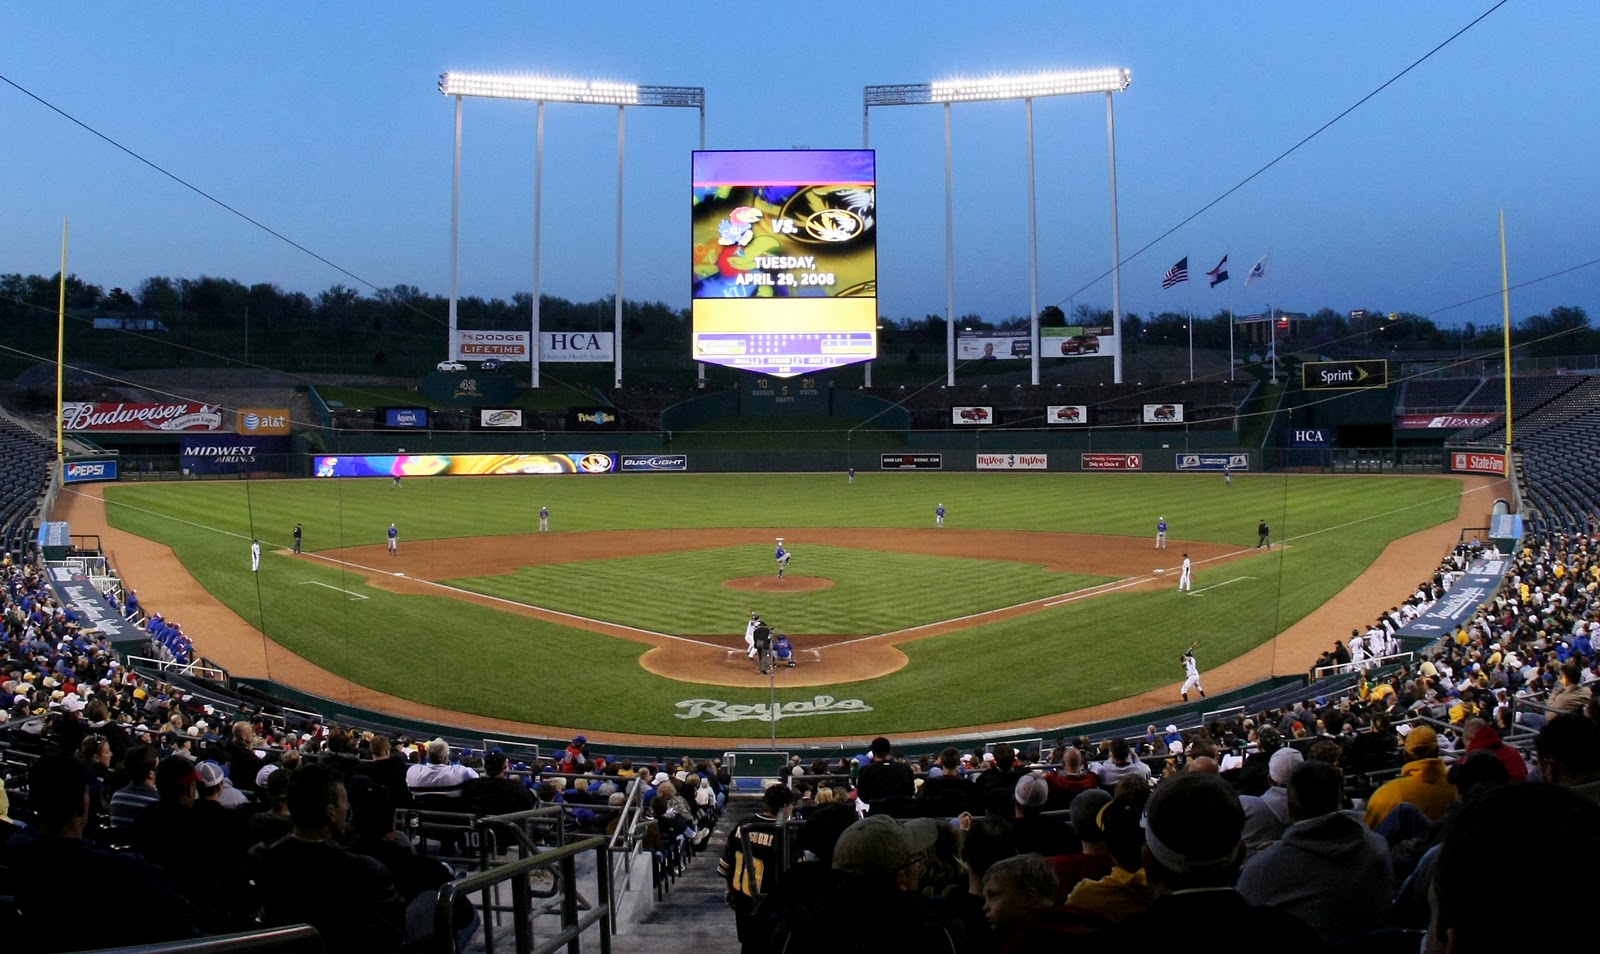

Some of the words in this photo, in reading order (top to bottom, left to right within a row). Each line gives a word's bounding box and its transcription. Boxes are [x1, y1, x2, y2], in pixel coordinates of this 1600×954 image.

[771, 219, 798, 233] VS.
[753, 256, 816, 270] TUESDAY,
[735, 273, 775, 286] APRIL
[777, 273, 798, 287] 29,
[801, 273, 835, 286] 2008
[551, 333, 601, 350] HCA
[464, 345, 521, 353] LIFETIME
[1321, 370, 1353, 384] Sprint
[460, 379, 477, 391] 42
[757, 379, 768, 389] 10
[802, 379, 814, 388] 20
[782, 386, 788, 395] 5
[62, 402, 188, 430] Budweiser
[261, 416, 285, 428] at&t
[1450, 417, 1492, 425] PARK
[1295, 430, 1324, 441] HCA
[184, 446, 256, 456] MIDWEST
[75, 464, 105, 476] PEPSI
[674, 695, 874, 722] Royals
[464, 831, 480, 848] 10
[735, 826, 774, 847] MSOURI
